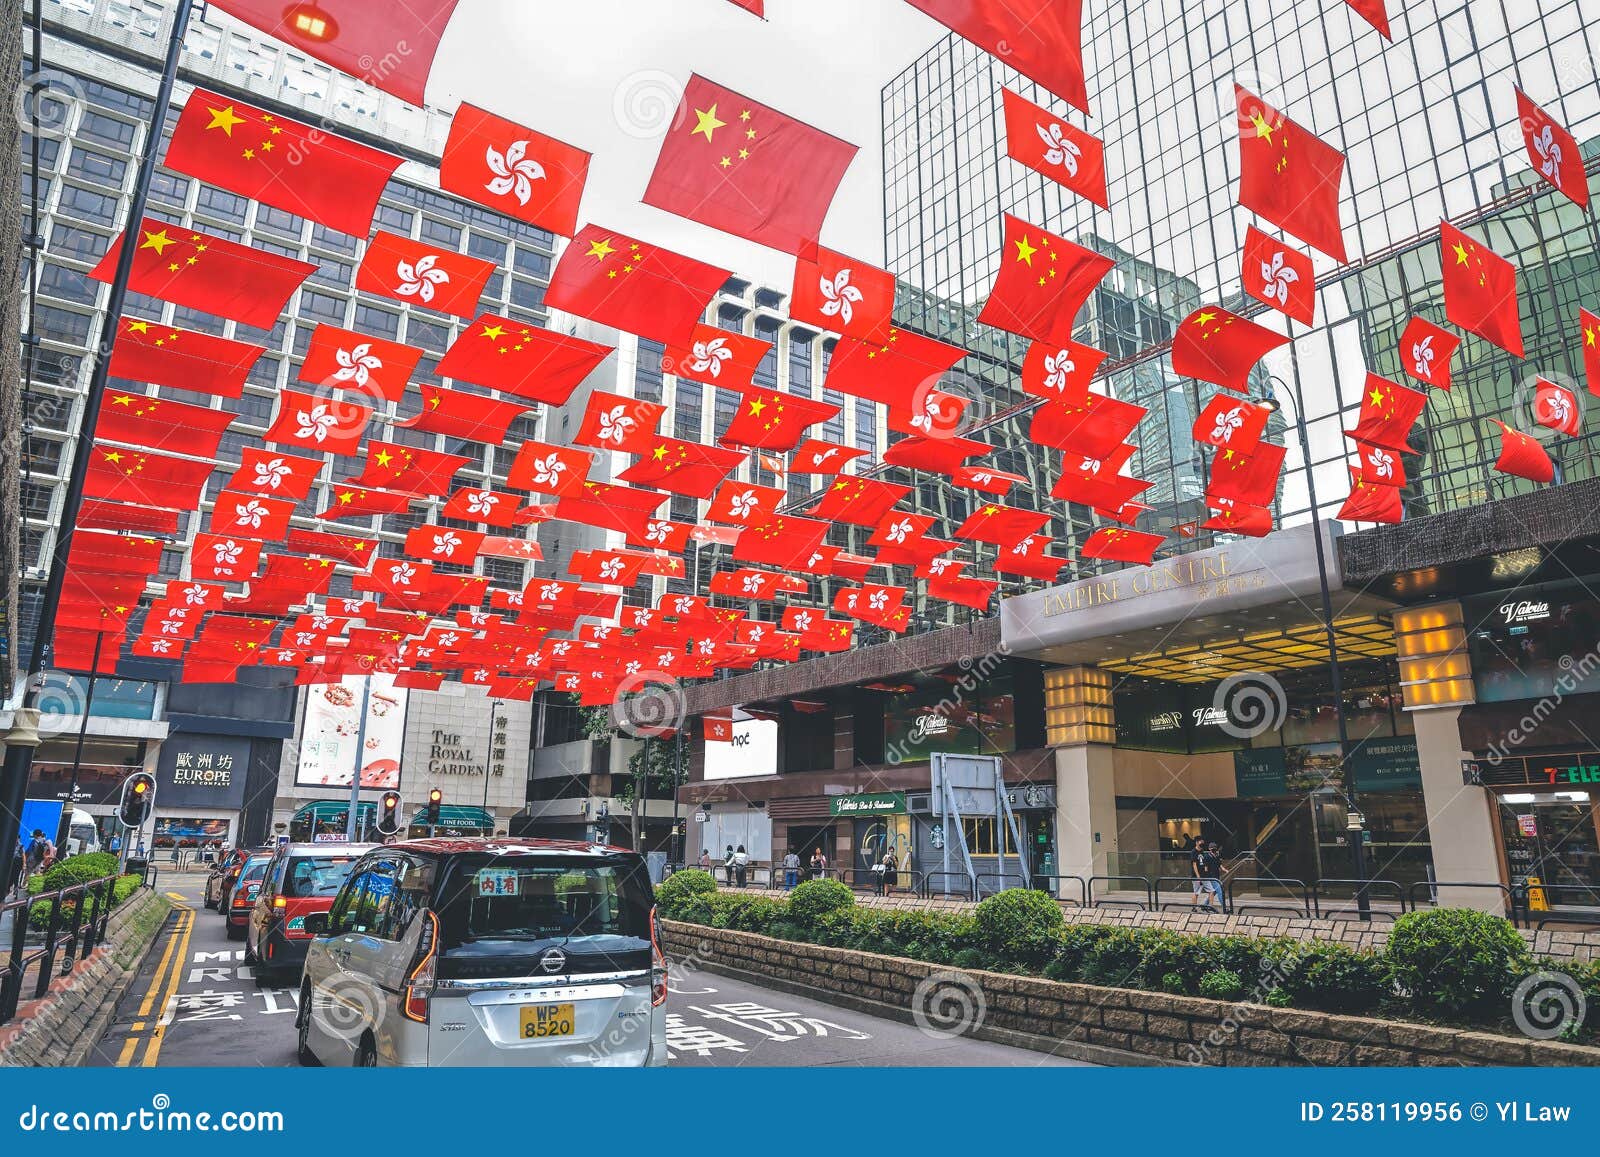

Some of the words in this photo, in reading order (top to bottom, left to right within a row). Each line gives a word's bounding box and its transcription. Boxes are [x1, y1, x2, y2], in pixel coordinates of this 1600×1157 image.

[1043, 579, 1120, 617] EMPIRE
[1132, 551, 1231, 595] CENTRE
[432, 730, 461, 745] THE
[430, 745, 473, 761] ROYAL
[490, 715, 508, 777] 帝苑酒店
[176, 752, 233, 769] 歐洲坊
[428, 760, 484, 776] GARDEN
[175, 769, 231, 781] EUROPE
[536, 1006, 559, 1021] WP
[525, 1020, 570, 1037] 8520
